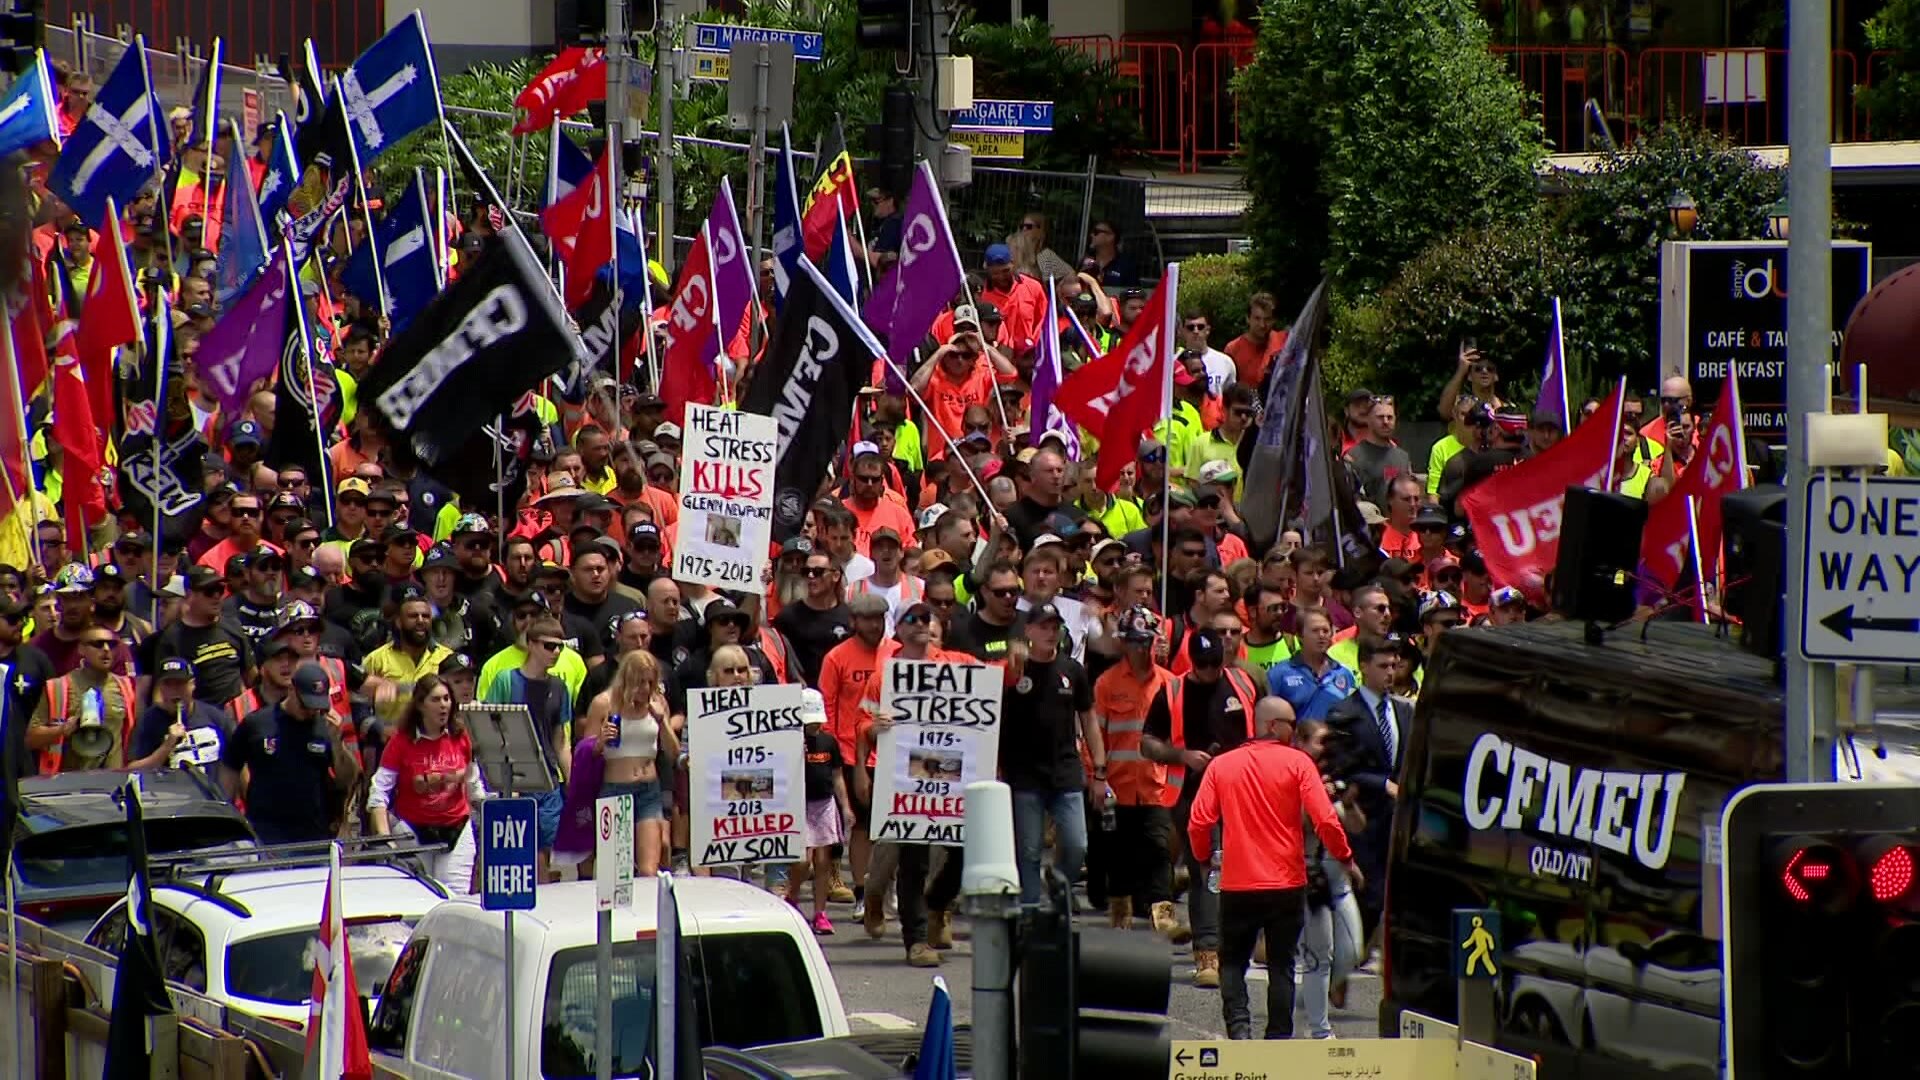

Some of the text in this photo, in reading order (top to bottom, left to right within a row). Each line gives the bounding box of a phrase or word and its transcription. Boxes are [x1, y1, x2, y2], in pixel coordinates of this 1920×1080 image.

[803, 34, 818, 49] ST
[947, 103, 1048, 120] ARGARET ST
[976, 145, 999, 156] AREA
[983, 133, 1020, 145] CENTRAL
[1732, 260, 1746, 299] simply
[1707, 327, 1745, 348] CAFÉ
[1751, 331, 1761, 348] &
[1699, 361, 1785, 379] BREKFAST
[692, 408, 745, 436] HEAT
[704, 435, 775, 463] STRESS
[691, 459, 764, 499] KILLS
[1828, 494, 1920, 537] ONE
[679, 554, 753, 583] 1975-2013
[1819, 551, 1920, 594] WAY
[893, 662, 985, 695] HEAT
[699, 687, 753, 715] HEAT
[891, 695, 997, 727] STRESS
[725, 706, 803, 737] STRESS
[919, 731, 962, 747] 1975-
[727, 745, 775, 766] 1975-
[915, 779, 950, 796] 2013
[1464, 732, 1688, 870] CFMEU
[727, 800, 763, 817] 2013
[492, 819, 528, 849] PAY
[713, 813, 795, 839] KILLED
[878, 820, 965, 843] MY MAT
[701, 835, 790, 865] MY SON
[1530, 846, 1593, 882] QLD/NT
[487, 864, 533, 895] HERE
